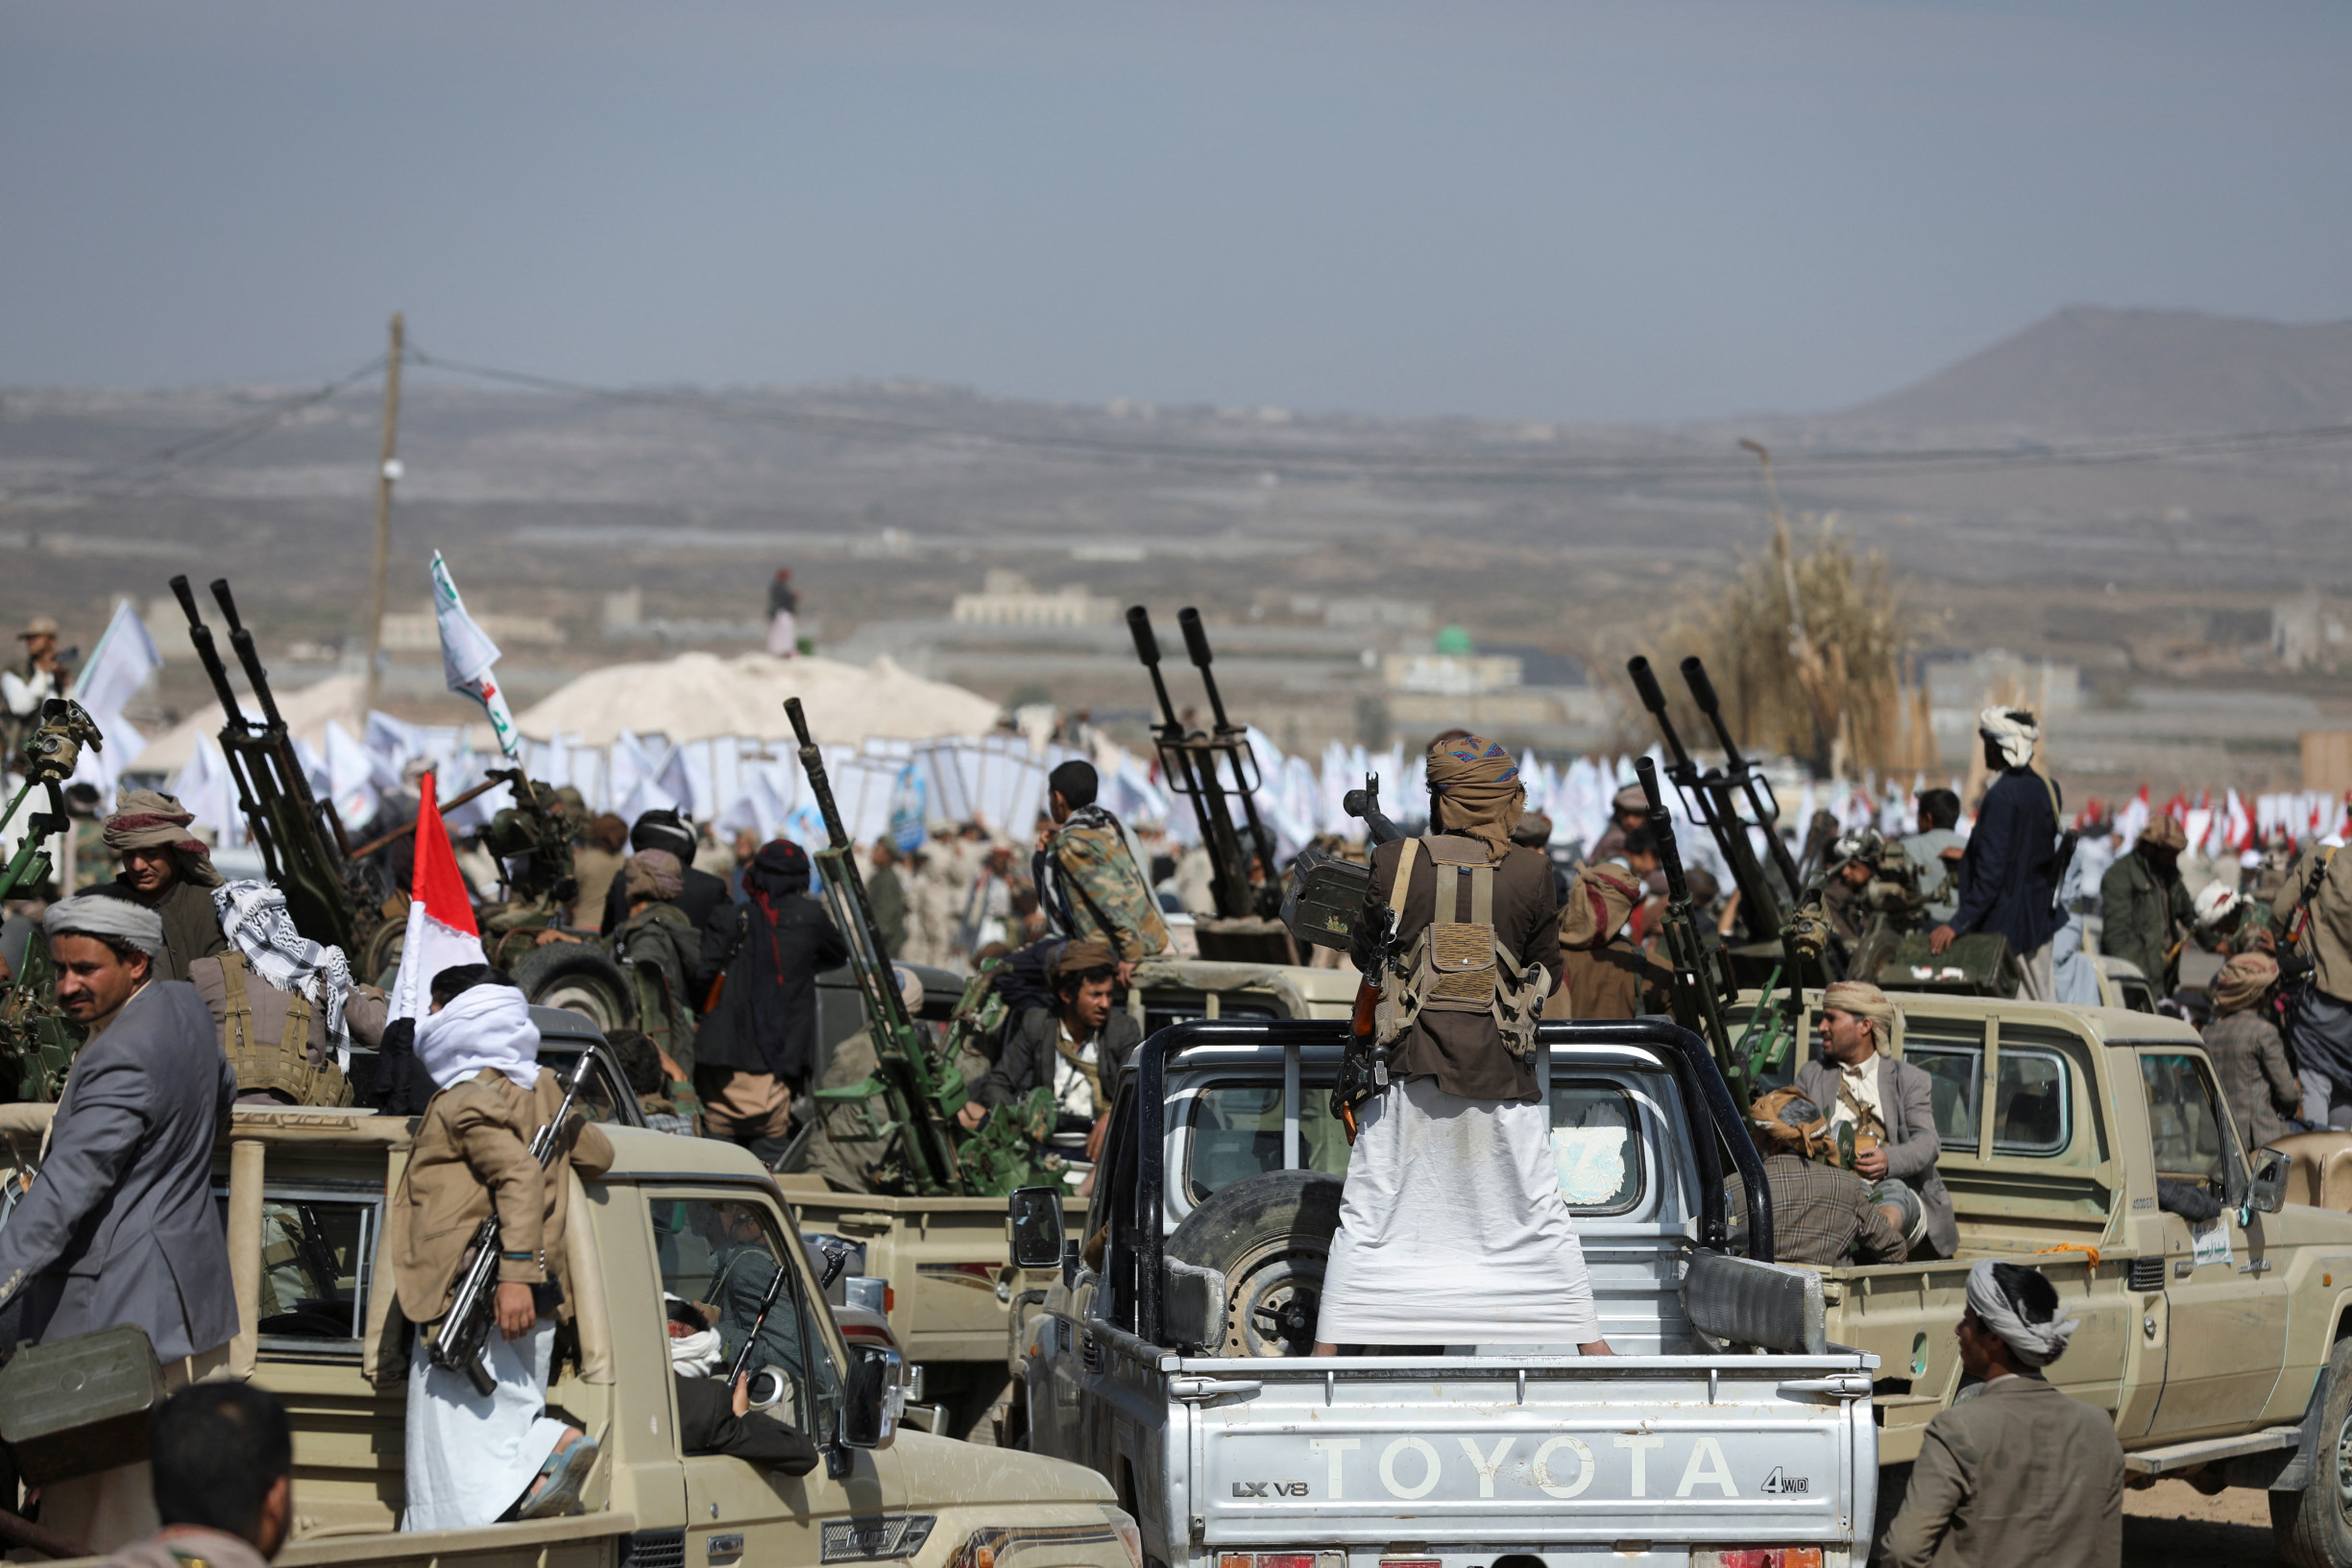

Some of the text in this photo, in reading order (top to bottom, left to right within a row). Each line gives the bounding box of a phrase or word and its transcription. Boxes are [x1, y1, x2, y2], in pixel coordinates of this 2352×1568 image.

[1309, 1436, 1739, 1498] TOYOTA
[1760, 1466, 1808, 1493] 4WD
[1232, 1482, 1309, 1497] LX V8
